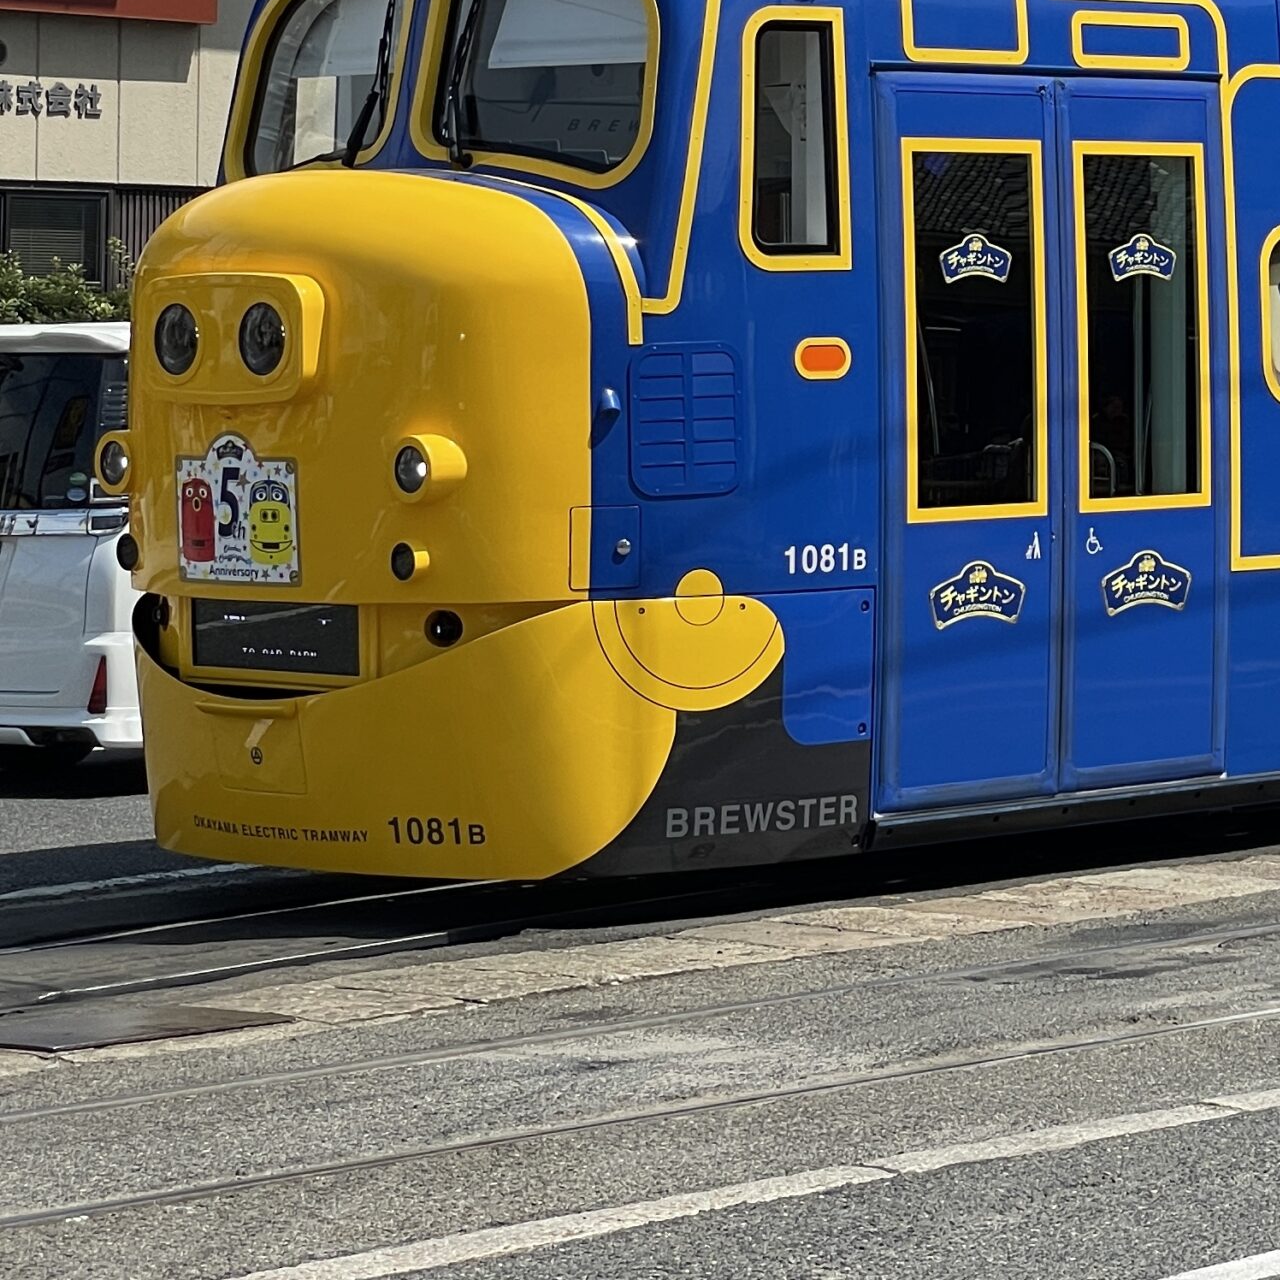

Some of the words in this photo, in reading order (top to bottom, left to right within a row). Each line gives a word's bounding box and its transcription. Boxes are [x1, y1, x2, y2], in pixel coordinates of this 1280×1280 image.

[948, 251, 1004, 269] チャギントン
[1116, 250, 1169, 268] チャギントン
[784, 543, 867, 574] 1081B
[209, 565, 260, 580] Anniversary
[1111, 573, 1182, 599] チャギントン
[940, 585, 1015, 612] チャギントン
[194, 815, 239, 834] OKAYAMA
[242, 823, 299, 841] ELECTRIC
[302, 828, 369, 843] TRAMWAY
[665, 794, 859, 839] BREWSTER
[388, 816, 487, 846] 1081B
